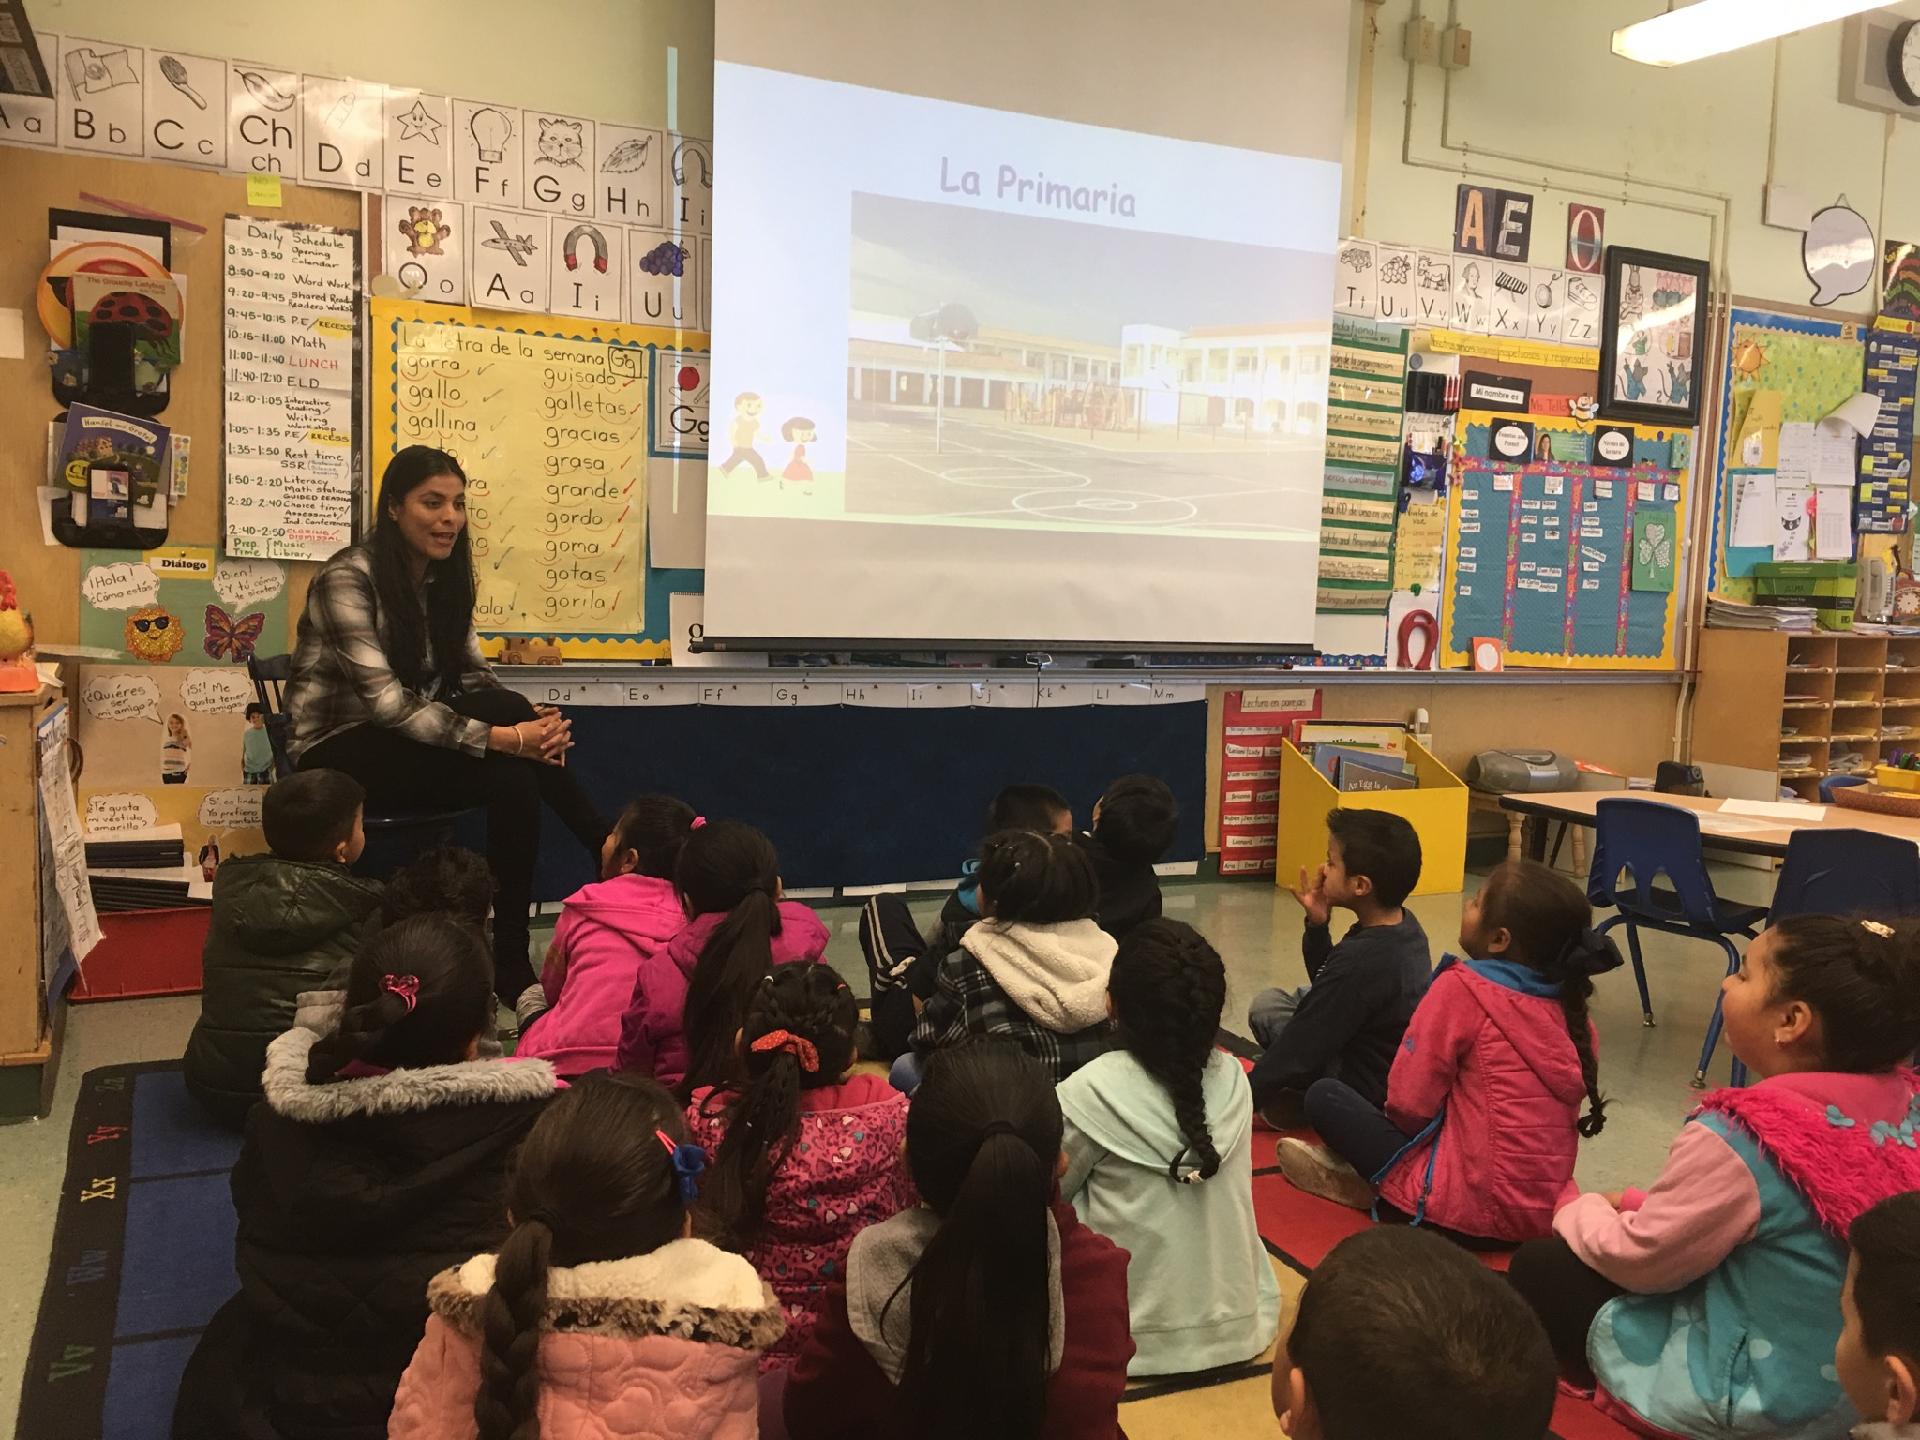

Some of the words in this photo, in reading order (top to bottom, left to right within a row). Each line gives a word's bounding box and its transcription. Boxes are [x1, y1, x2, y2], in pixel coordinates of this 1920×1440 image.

[240, 115, 292, 149] Ch
[251, 153, 281, 173] ch
[940, 156, 981, 196] La
[997, 164, 1136, 217] Primaria
[1461, 189, 1485, 252] A
[1496, 199, 1529, 256] E
[248, 225, 284, 249] Daily
[292, 232, 345, 249] Schedule
[291, 247, 331, 259] Opening
[292, 274, 323, 287] Word
[327, 279, 352, 290] Work
[292, 292, 326, 302] Shared
[291, 336, 326, 350] Math
[404, 325, 425, 348] La
[490, 336, 512, 356] de
[518, 337, 533, 358] la
[543, 348, 605, 366] semana
[289, 355, 338, 370] LUNCH
[407, 356, 460, 377] gorra
[544, 367, 616, 390] guisado
[287, 375, 320, 389] ELD
[408, 378, 461, 407] gallo
[544, 392, 627, 418] galletas
[1475, 387, 1484, 396] Mi
[1484, 389, 1510, 401] nombre
[286, 413, 328, 425] Writing
[408, 407, 477, 437] gallina
[546, 425, 620, 448] gracias
[285, 448, 308, 459] Rest
[315, 450, 344, 461] time
[280, 460, 306, 470] SSR
[546, 455, 606, 476] grasa
[284, 476, 329, 490] Literacy
[284, 486, 313, 494] Math
[546, 478, 619, 504] grande
[546, 508, 603, 533] gordo
[273, 541, 305, 549] Music
[546, 539, 599, 562] goma
[273, 549, 312, 560] Library
[161, 559, 207, 570] Diálogo
[546, 561, 606, 589] gotas
[545, 590, 606, 618] gorila
[212, 682, 231, 692] Me
[111, 698, 128, 708] ser
[190, 696, 216, 708] gusta
[219, 692, 247, 703] tener
[1359, 780, 1373, 790] Egg
[109, 803, 140, 815] gusta
[207, 808, 219, 817] Yo
[220, 808, 259, 820] prefiero
